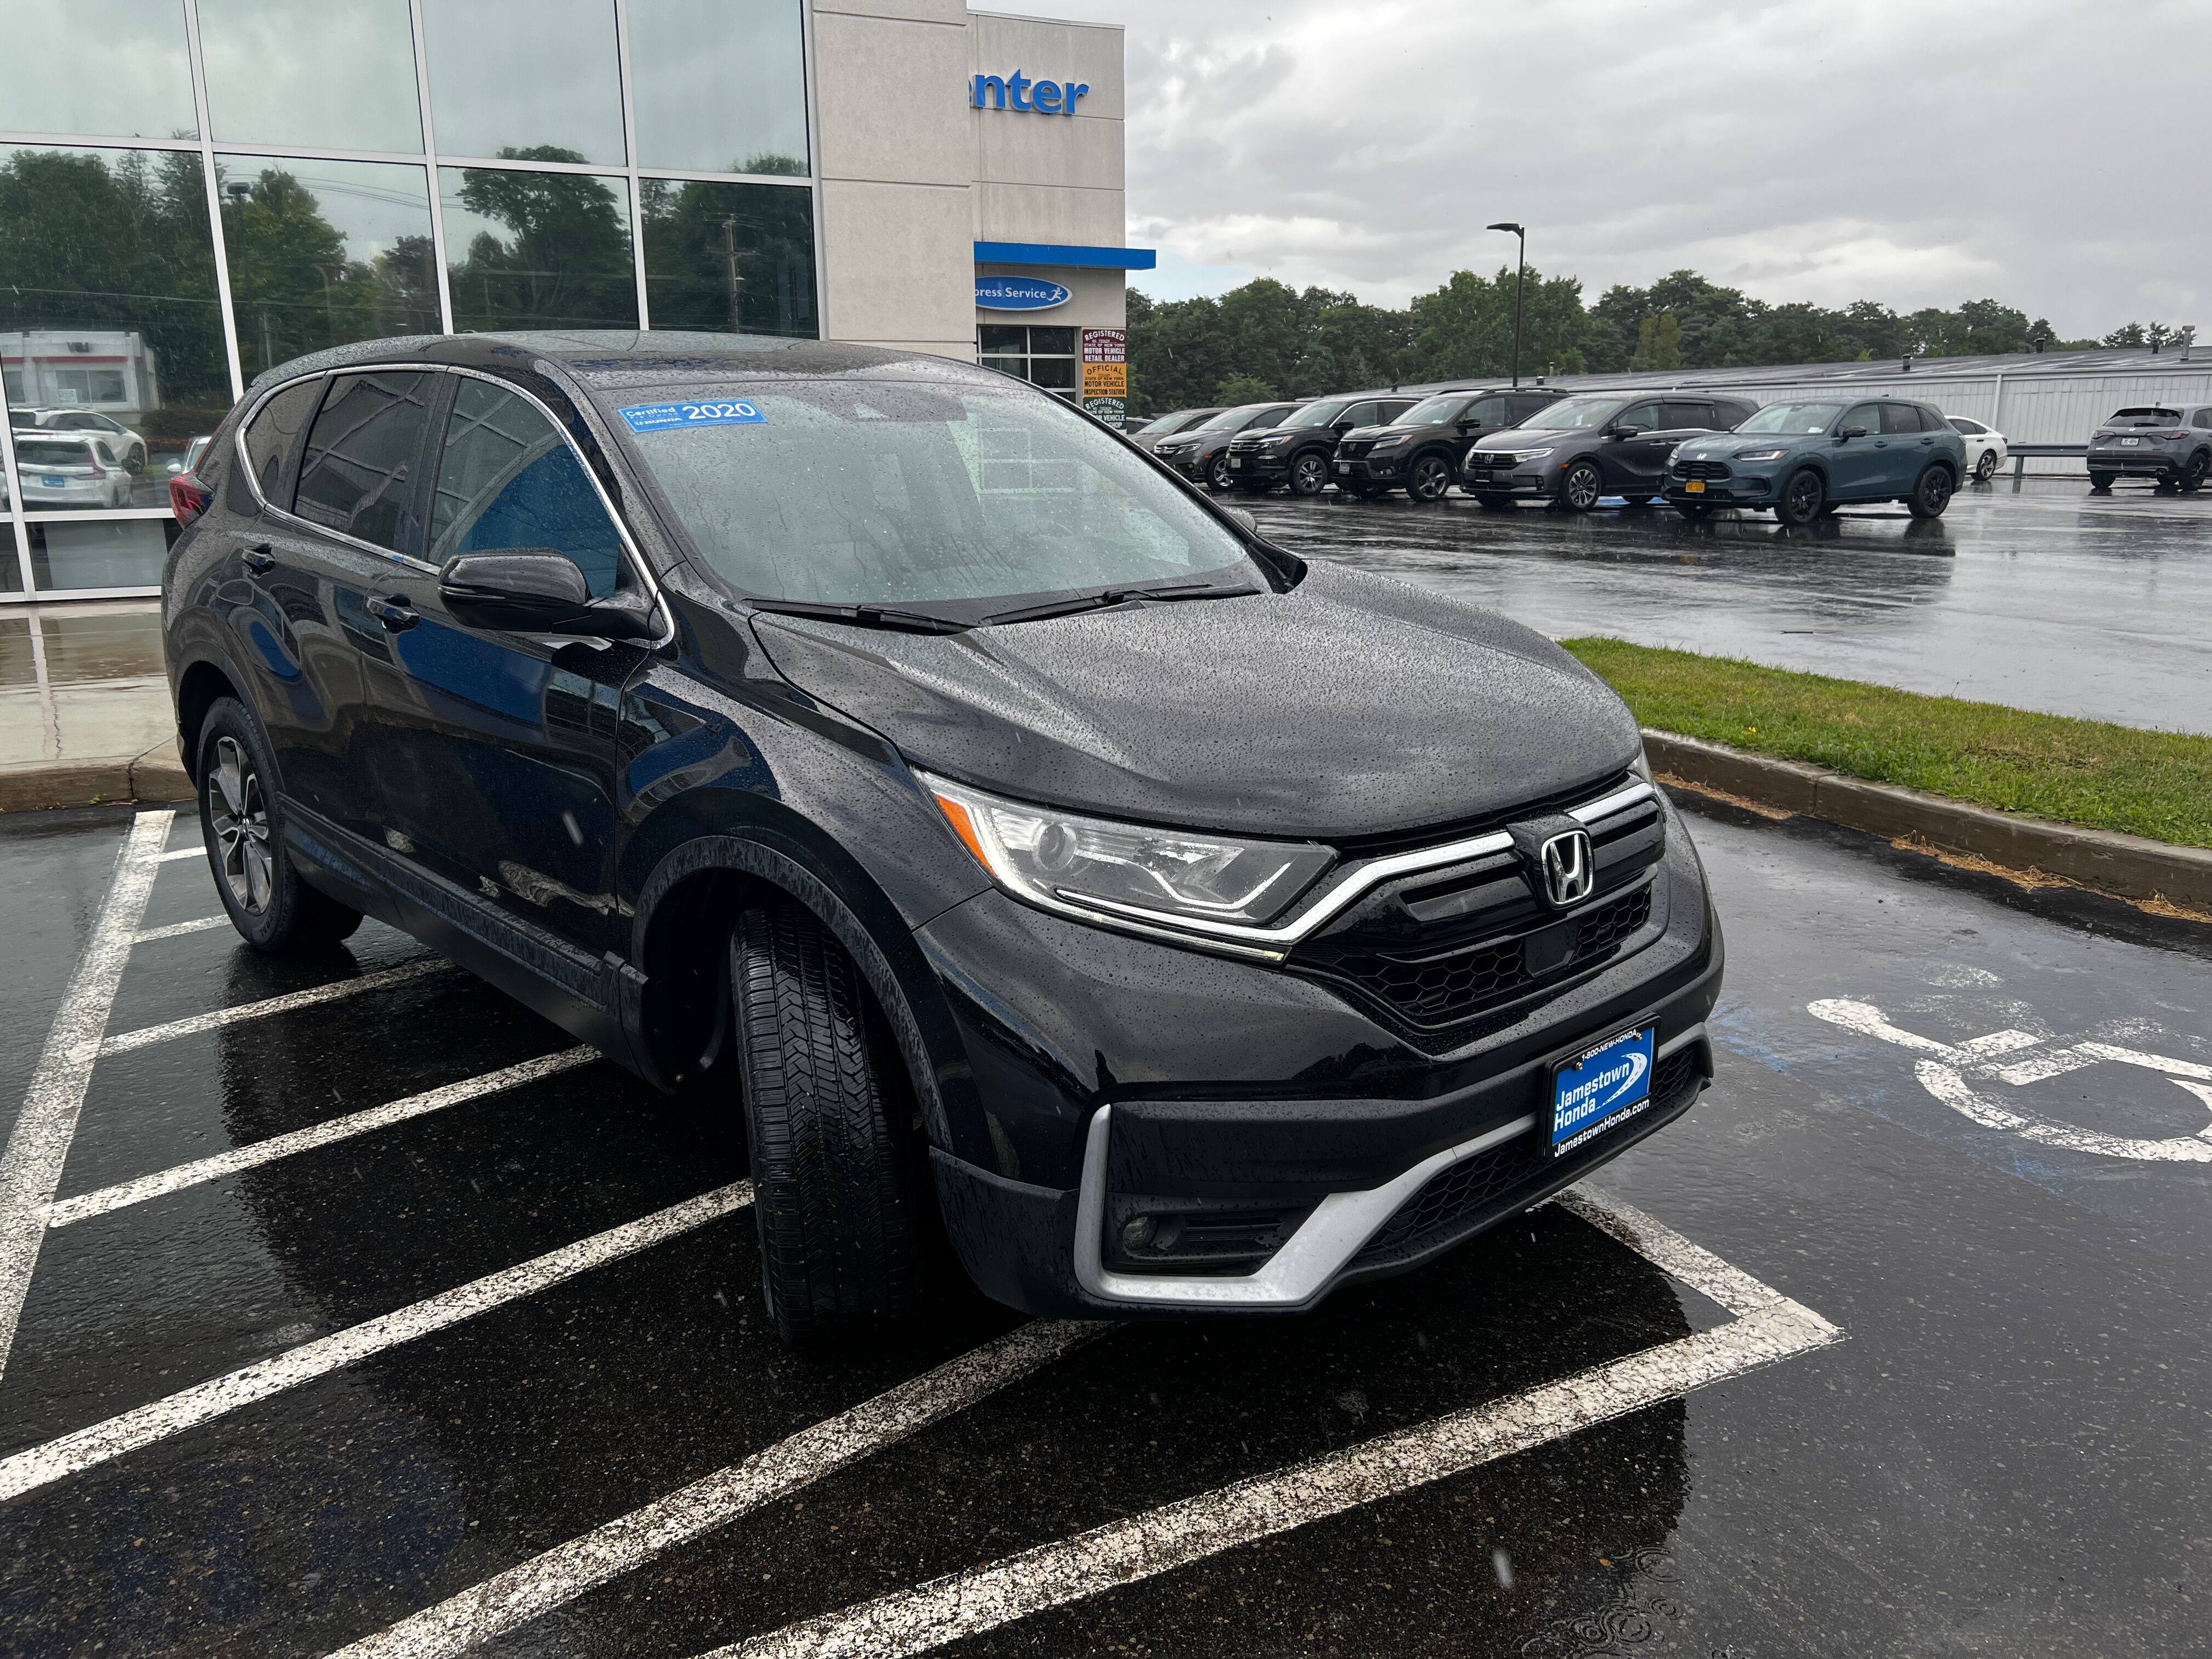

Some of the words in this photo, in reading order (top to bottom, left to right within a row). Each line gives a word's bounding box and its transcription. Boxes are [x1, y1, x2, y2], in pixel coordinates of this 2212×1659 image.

[968, 69, 1089, 114] nter
[1005, 287, 1047, 298] Service
[1084, 330, 1125, 341] REGISTERED
[1087, 365, 1123, 375] OFFICIAL
[626, 407, 676, 416] Certified
[682, 403, 756, 420] 2020
[1085, 397, 1125, 410] REGISTERED
[1581, 1029, 1637, 1062] 1-800-NEW-HONDA
[1556, 1062, 1630, 1111] Jamestown
[1554, 1098, 1596, 1132] Honda
[1554, 1098, 1650, 1158] JamestownHonda.com
